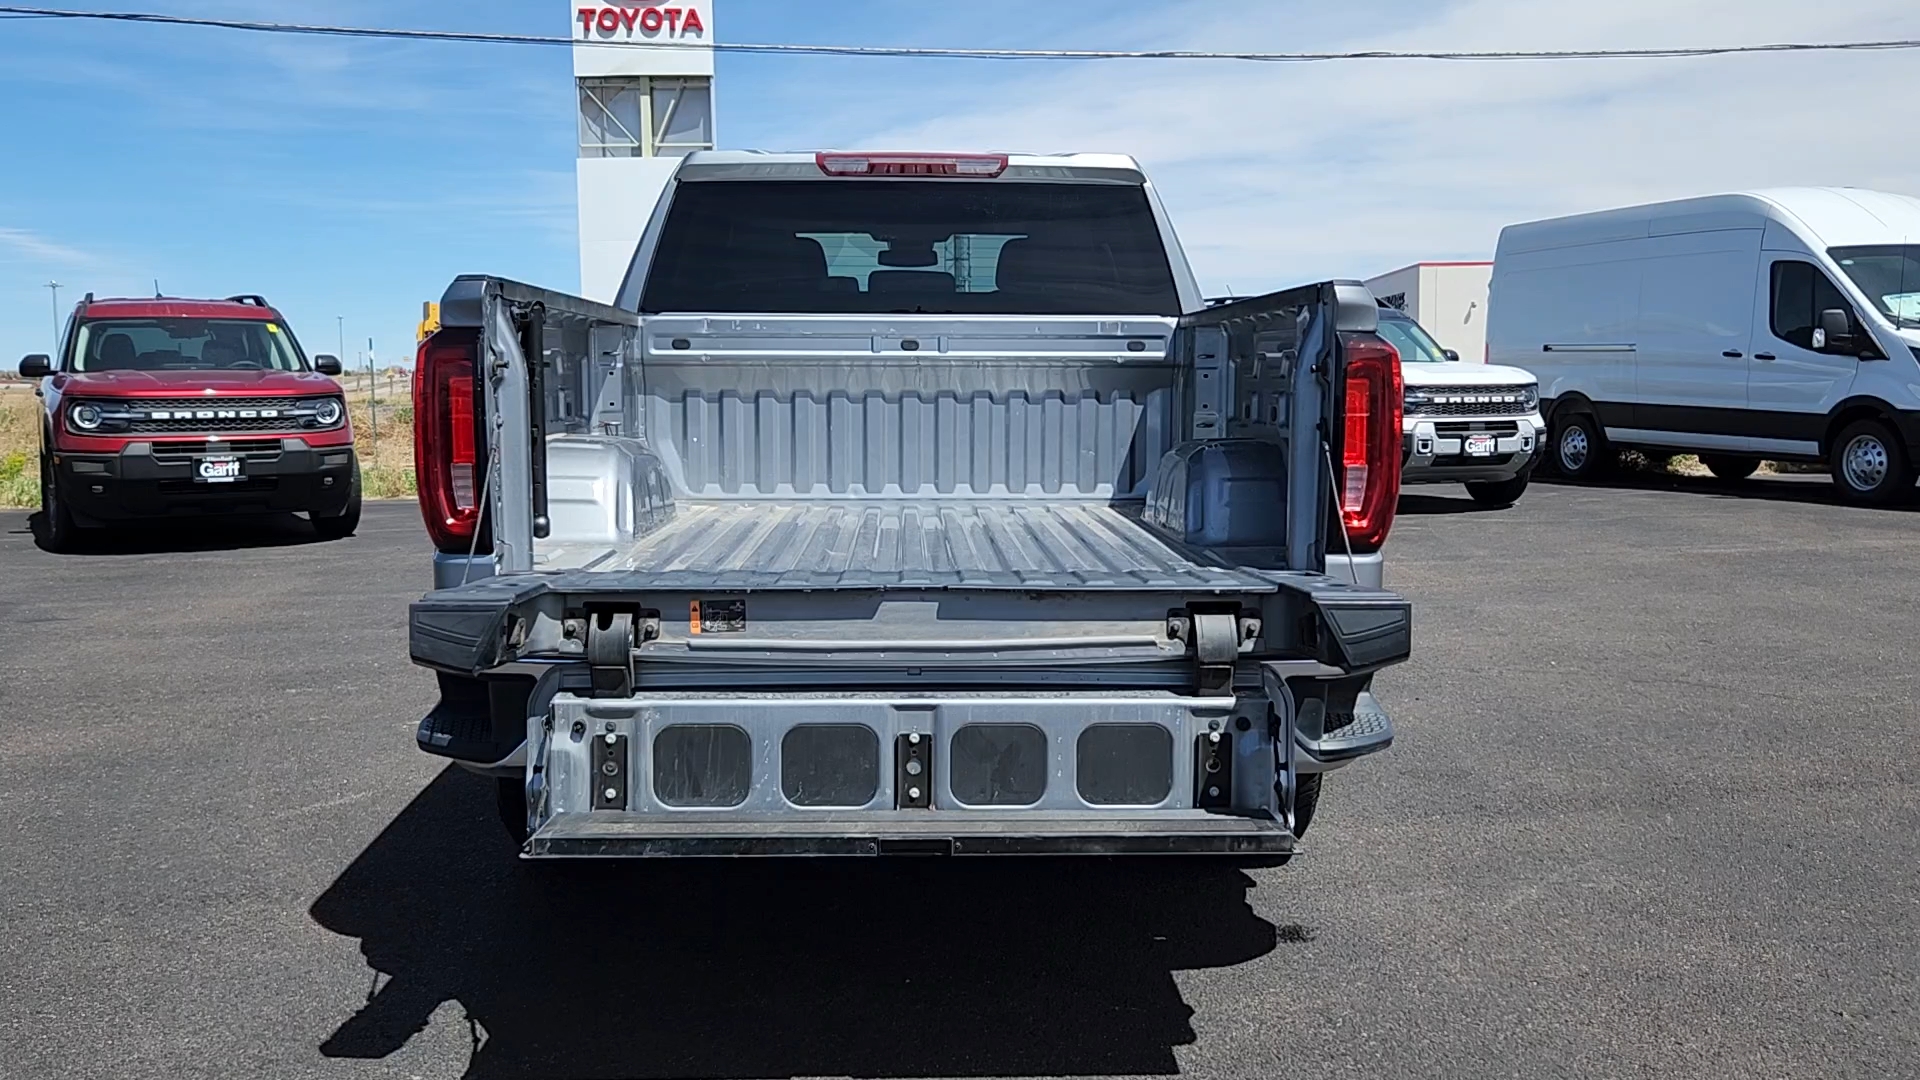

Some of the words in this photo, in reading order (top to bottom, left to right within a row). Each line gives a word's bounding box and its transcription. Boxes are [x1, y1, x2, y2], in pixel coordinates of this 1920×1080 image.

[578, 7, 704, 32] TOYOTA
[1433, 396, 1515, 404] BRONCO
[151, 410, 278, 419] BRONCO
[1464, 438, 1496, 453] Garff
[199, 461, 241, 477] Garff
